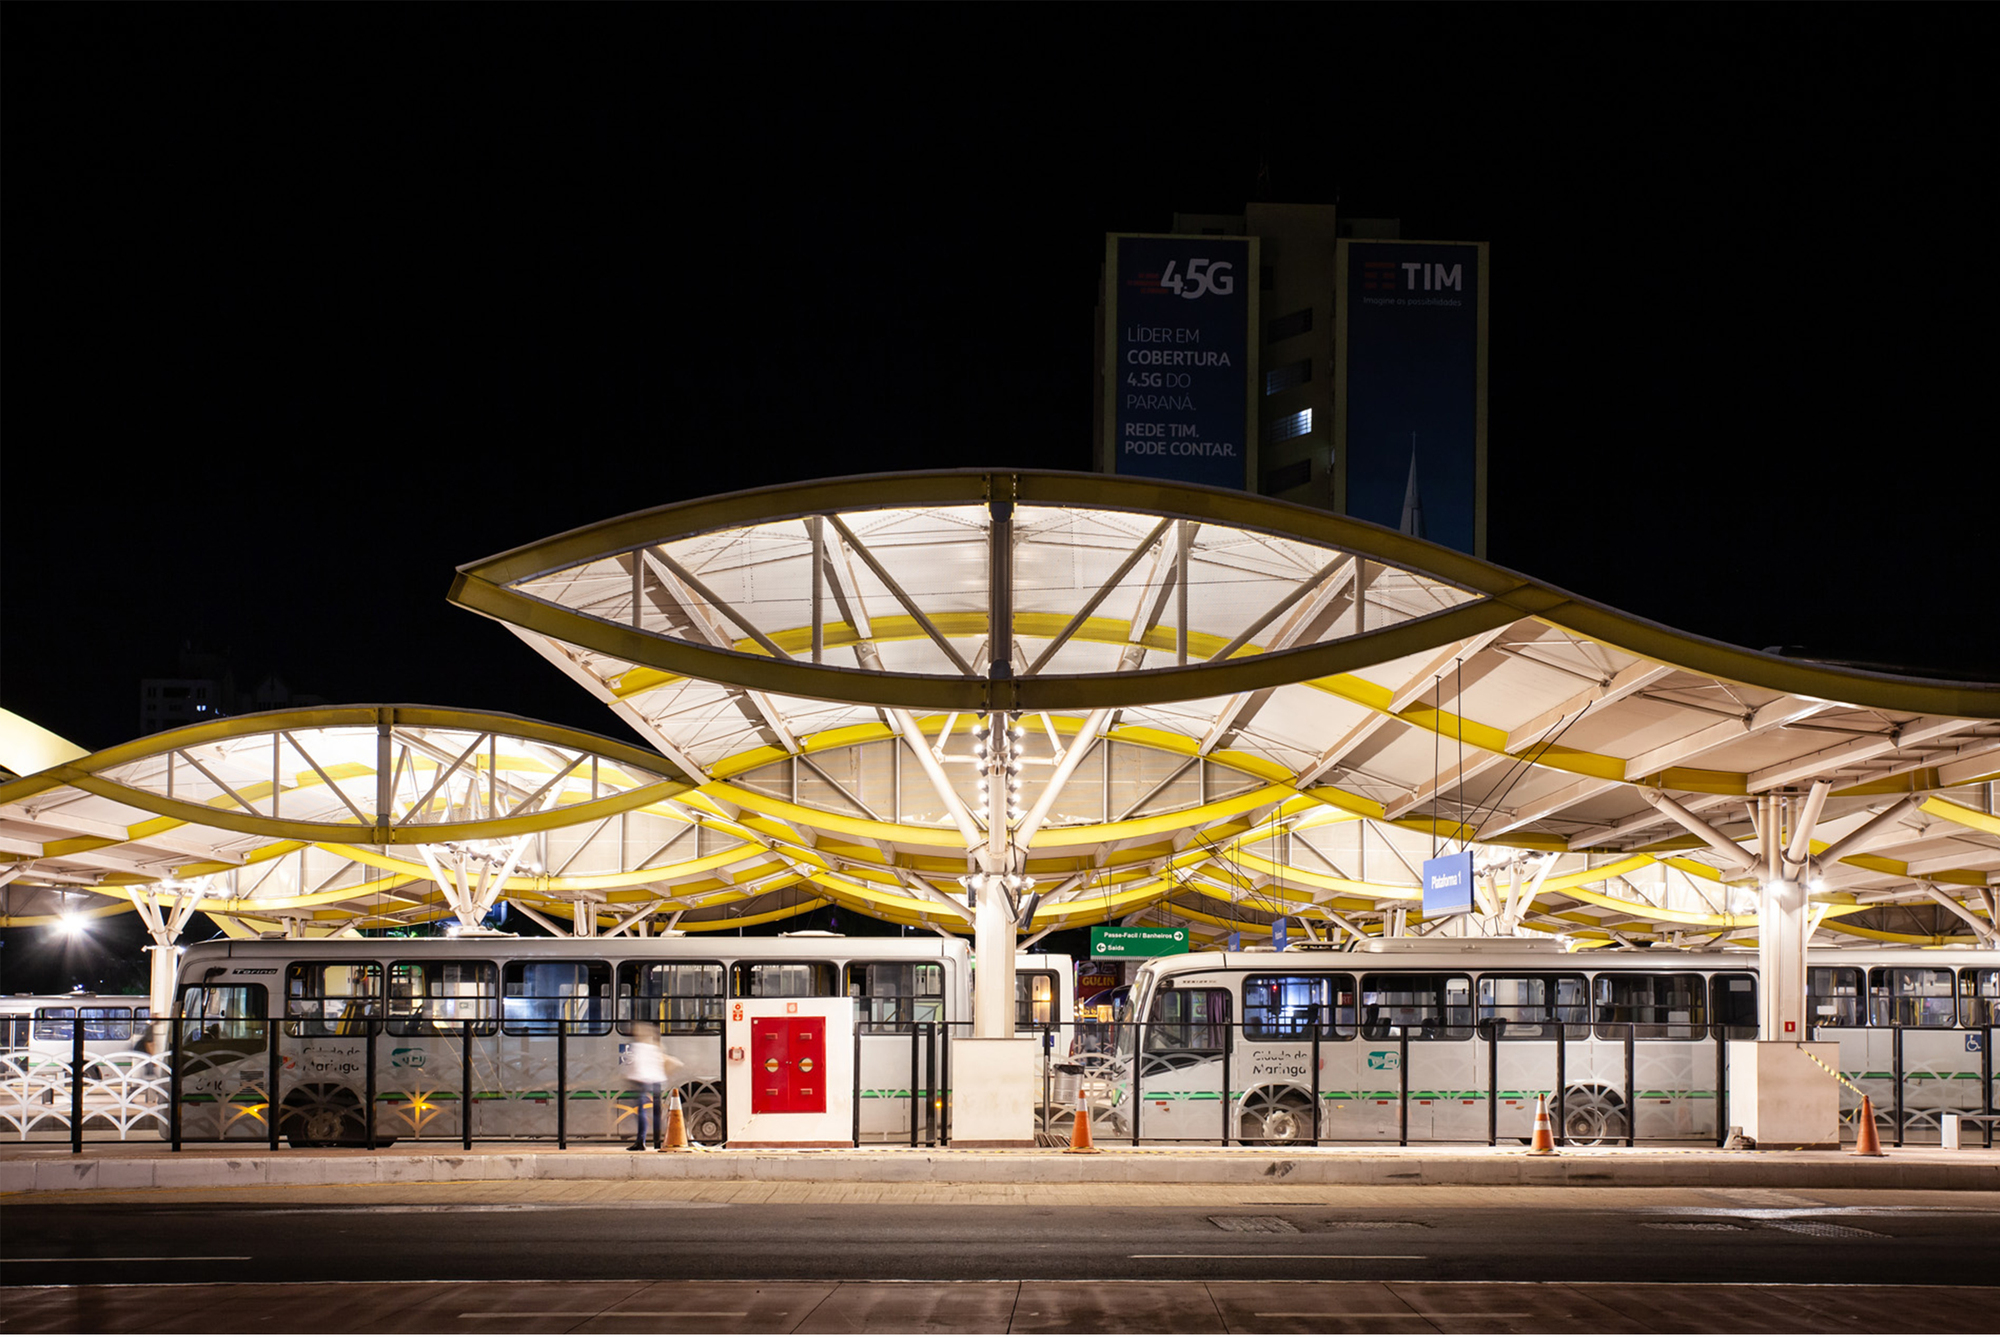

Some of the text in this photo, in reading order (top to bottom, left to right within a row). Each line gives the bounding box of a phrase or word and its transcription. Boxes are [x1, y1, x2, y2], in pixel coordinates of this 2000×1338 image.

[1401, 262, 1462, 291] TIM
[1363, 296, 1395, 306] Imagine
[1127, 324, 1200, 343] LÍDER EM
[1127, 350, 1231, 367] COBERTURA
[1127, 372, 1191, 388] 4.5G DO
[1126, 392, 1197, 411] PARANÁ.
[1125, 423, 1200, 438] REDE TIM.
[1125, 441, 1237, 457] PODE CONTAR.
[1431, 873, 1458, 890] Plataforma
[1082, 976, 1115, 986] GULIN
